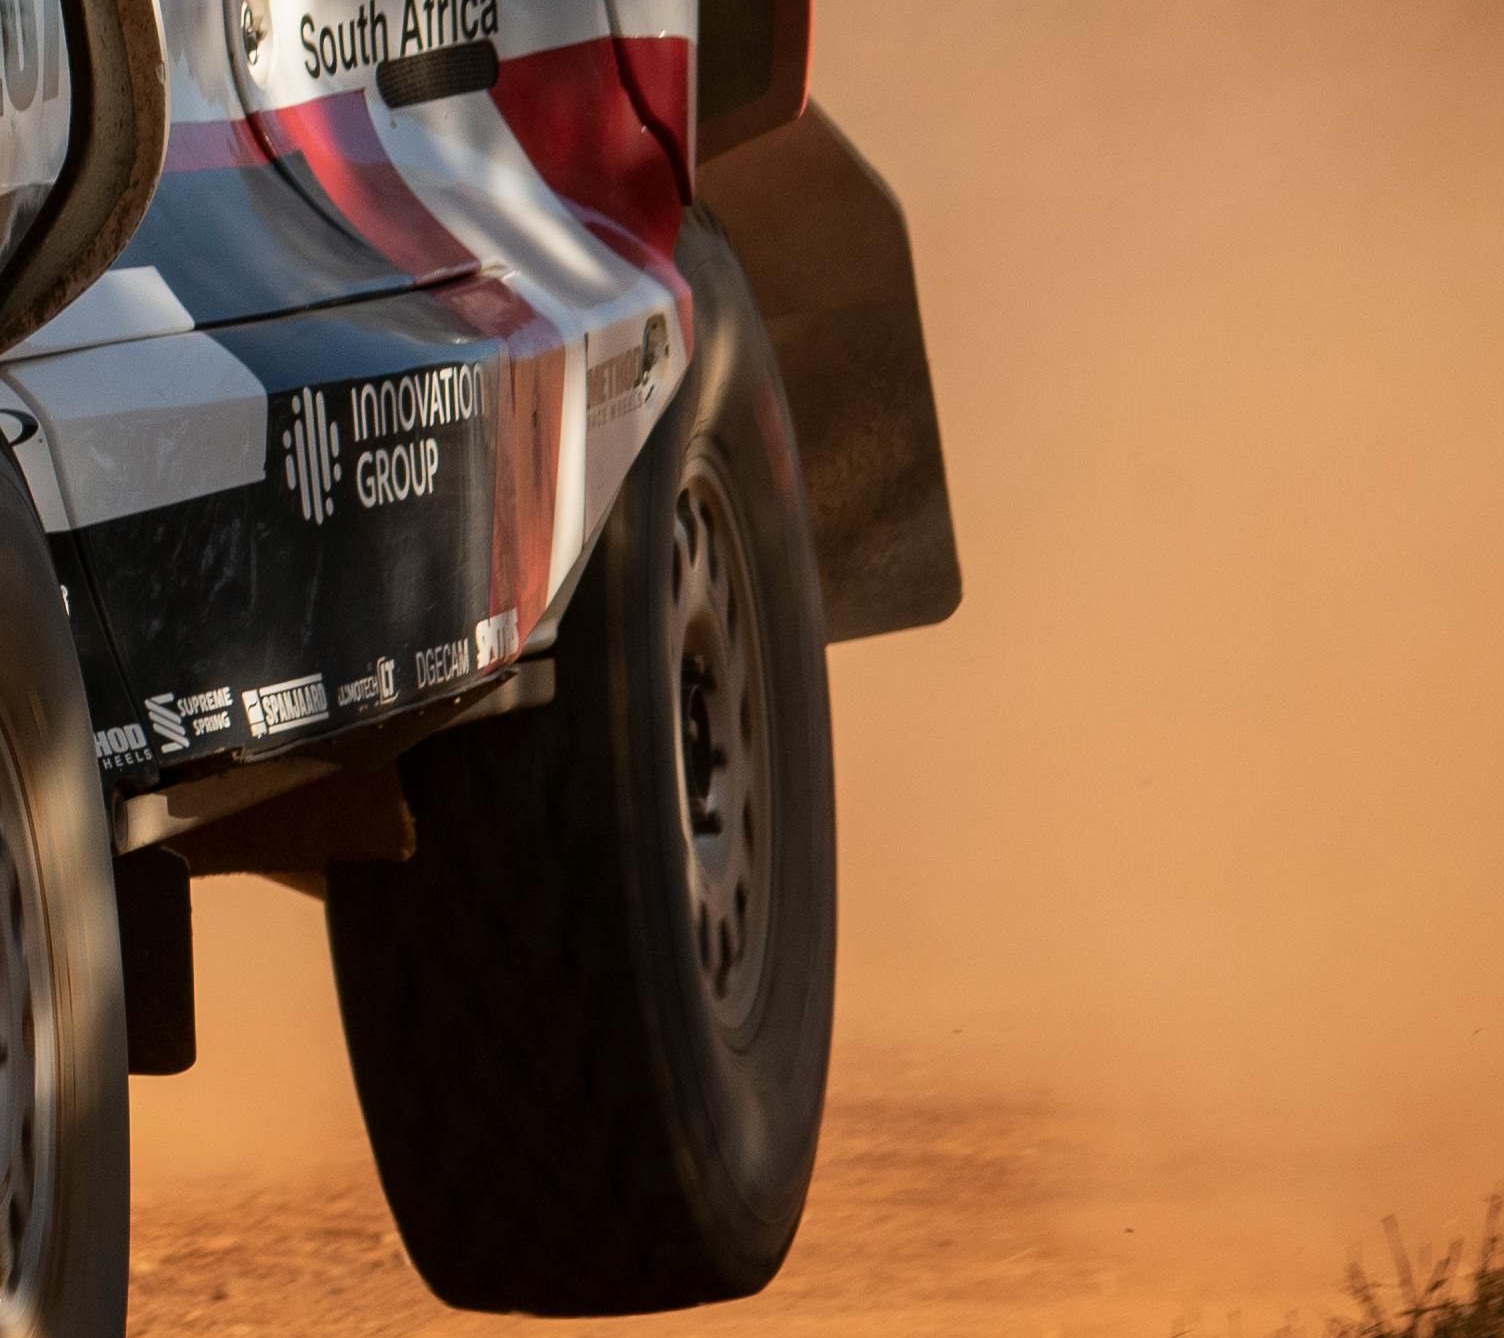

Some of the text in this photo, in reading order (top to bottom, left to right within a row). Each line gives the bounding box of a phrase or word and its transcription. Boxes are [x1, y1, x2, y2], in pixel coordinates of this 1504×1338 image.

[299, 4, 389, 80] South
[351, 361, 488, 442] INNOVATION
[355, 438, 440, 509] GROUP
[177, 685, 234, 718] SUPREME
[192, 710, 231, 737] SPRING
[261, 682, 329, 727] SPANJAARD
